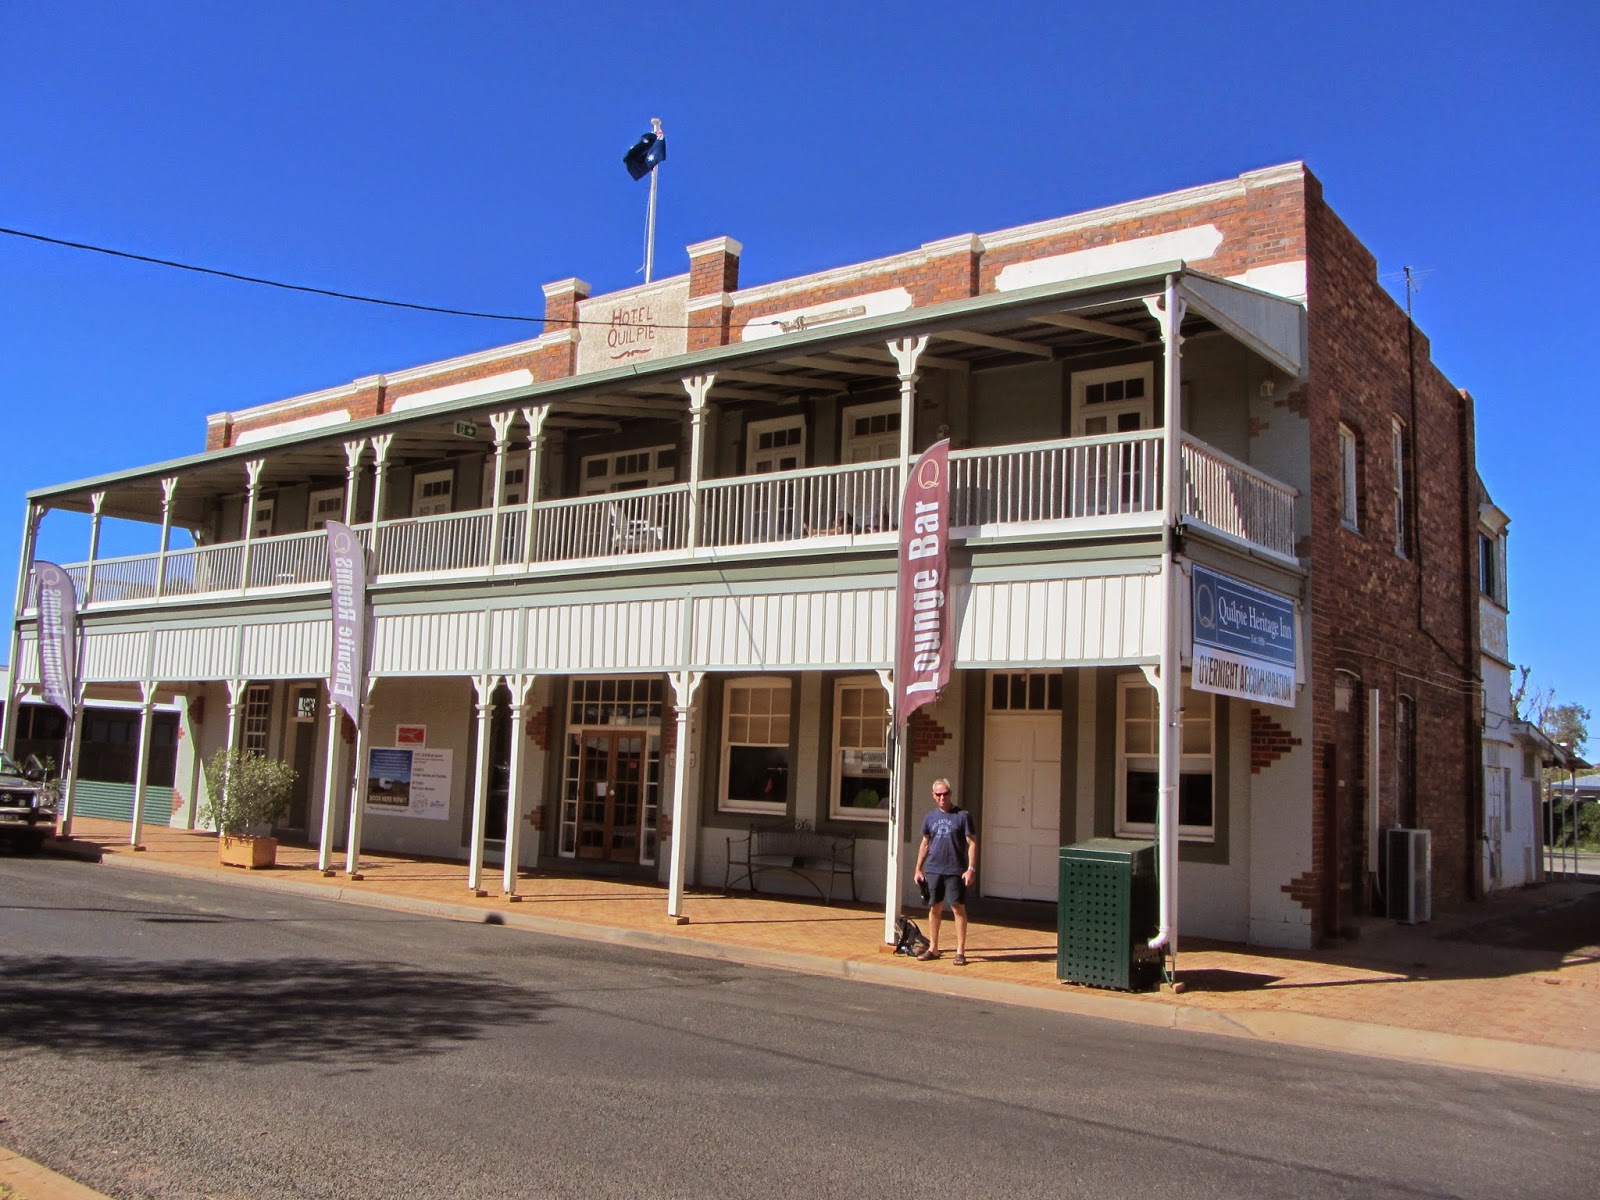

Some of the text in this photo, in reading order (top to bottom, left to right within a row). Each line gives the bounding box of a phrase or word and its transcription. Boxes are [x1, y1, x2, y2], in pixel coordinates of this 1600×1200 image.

[607, 325, 655, 348] QUILPIE
[611, 306, 653, 328] HOTEL
[906, 500, 945, 695] Lounge Bar
[1218, 596, 1292, 640] Quilpie Heritage Inn
[1199, 655, 1292, 701] OVERNIGHT ACCOMMODATION
